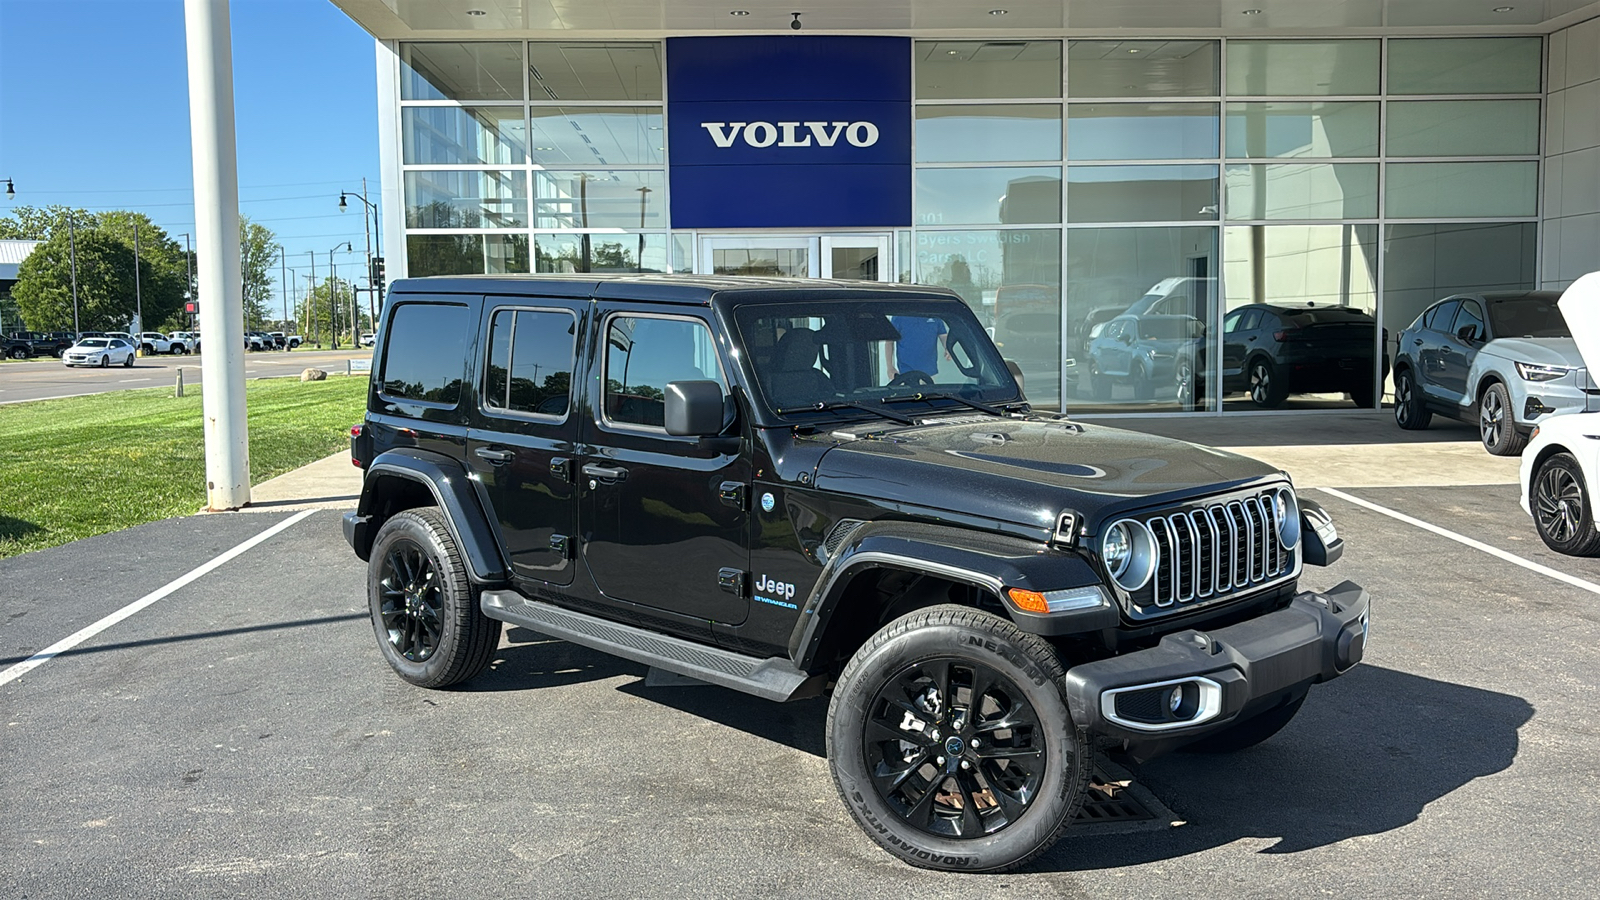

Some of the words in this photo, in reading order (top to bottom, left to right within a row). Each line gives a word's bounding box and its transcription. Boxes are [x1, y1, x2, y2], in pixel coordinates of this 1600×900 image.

[701, 121, 879, 147] VOLVO
[919, 212, 943, 224] 301
[919, 232, 960, 248] Byers
[966, 232, 1031, 244] Swedish
[919, 250, 954, 263] Cars
[755, 574, 796, 600] Jeep
[887, 836, 970, 866] ROADIAN
